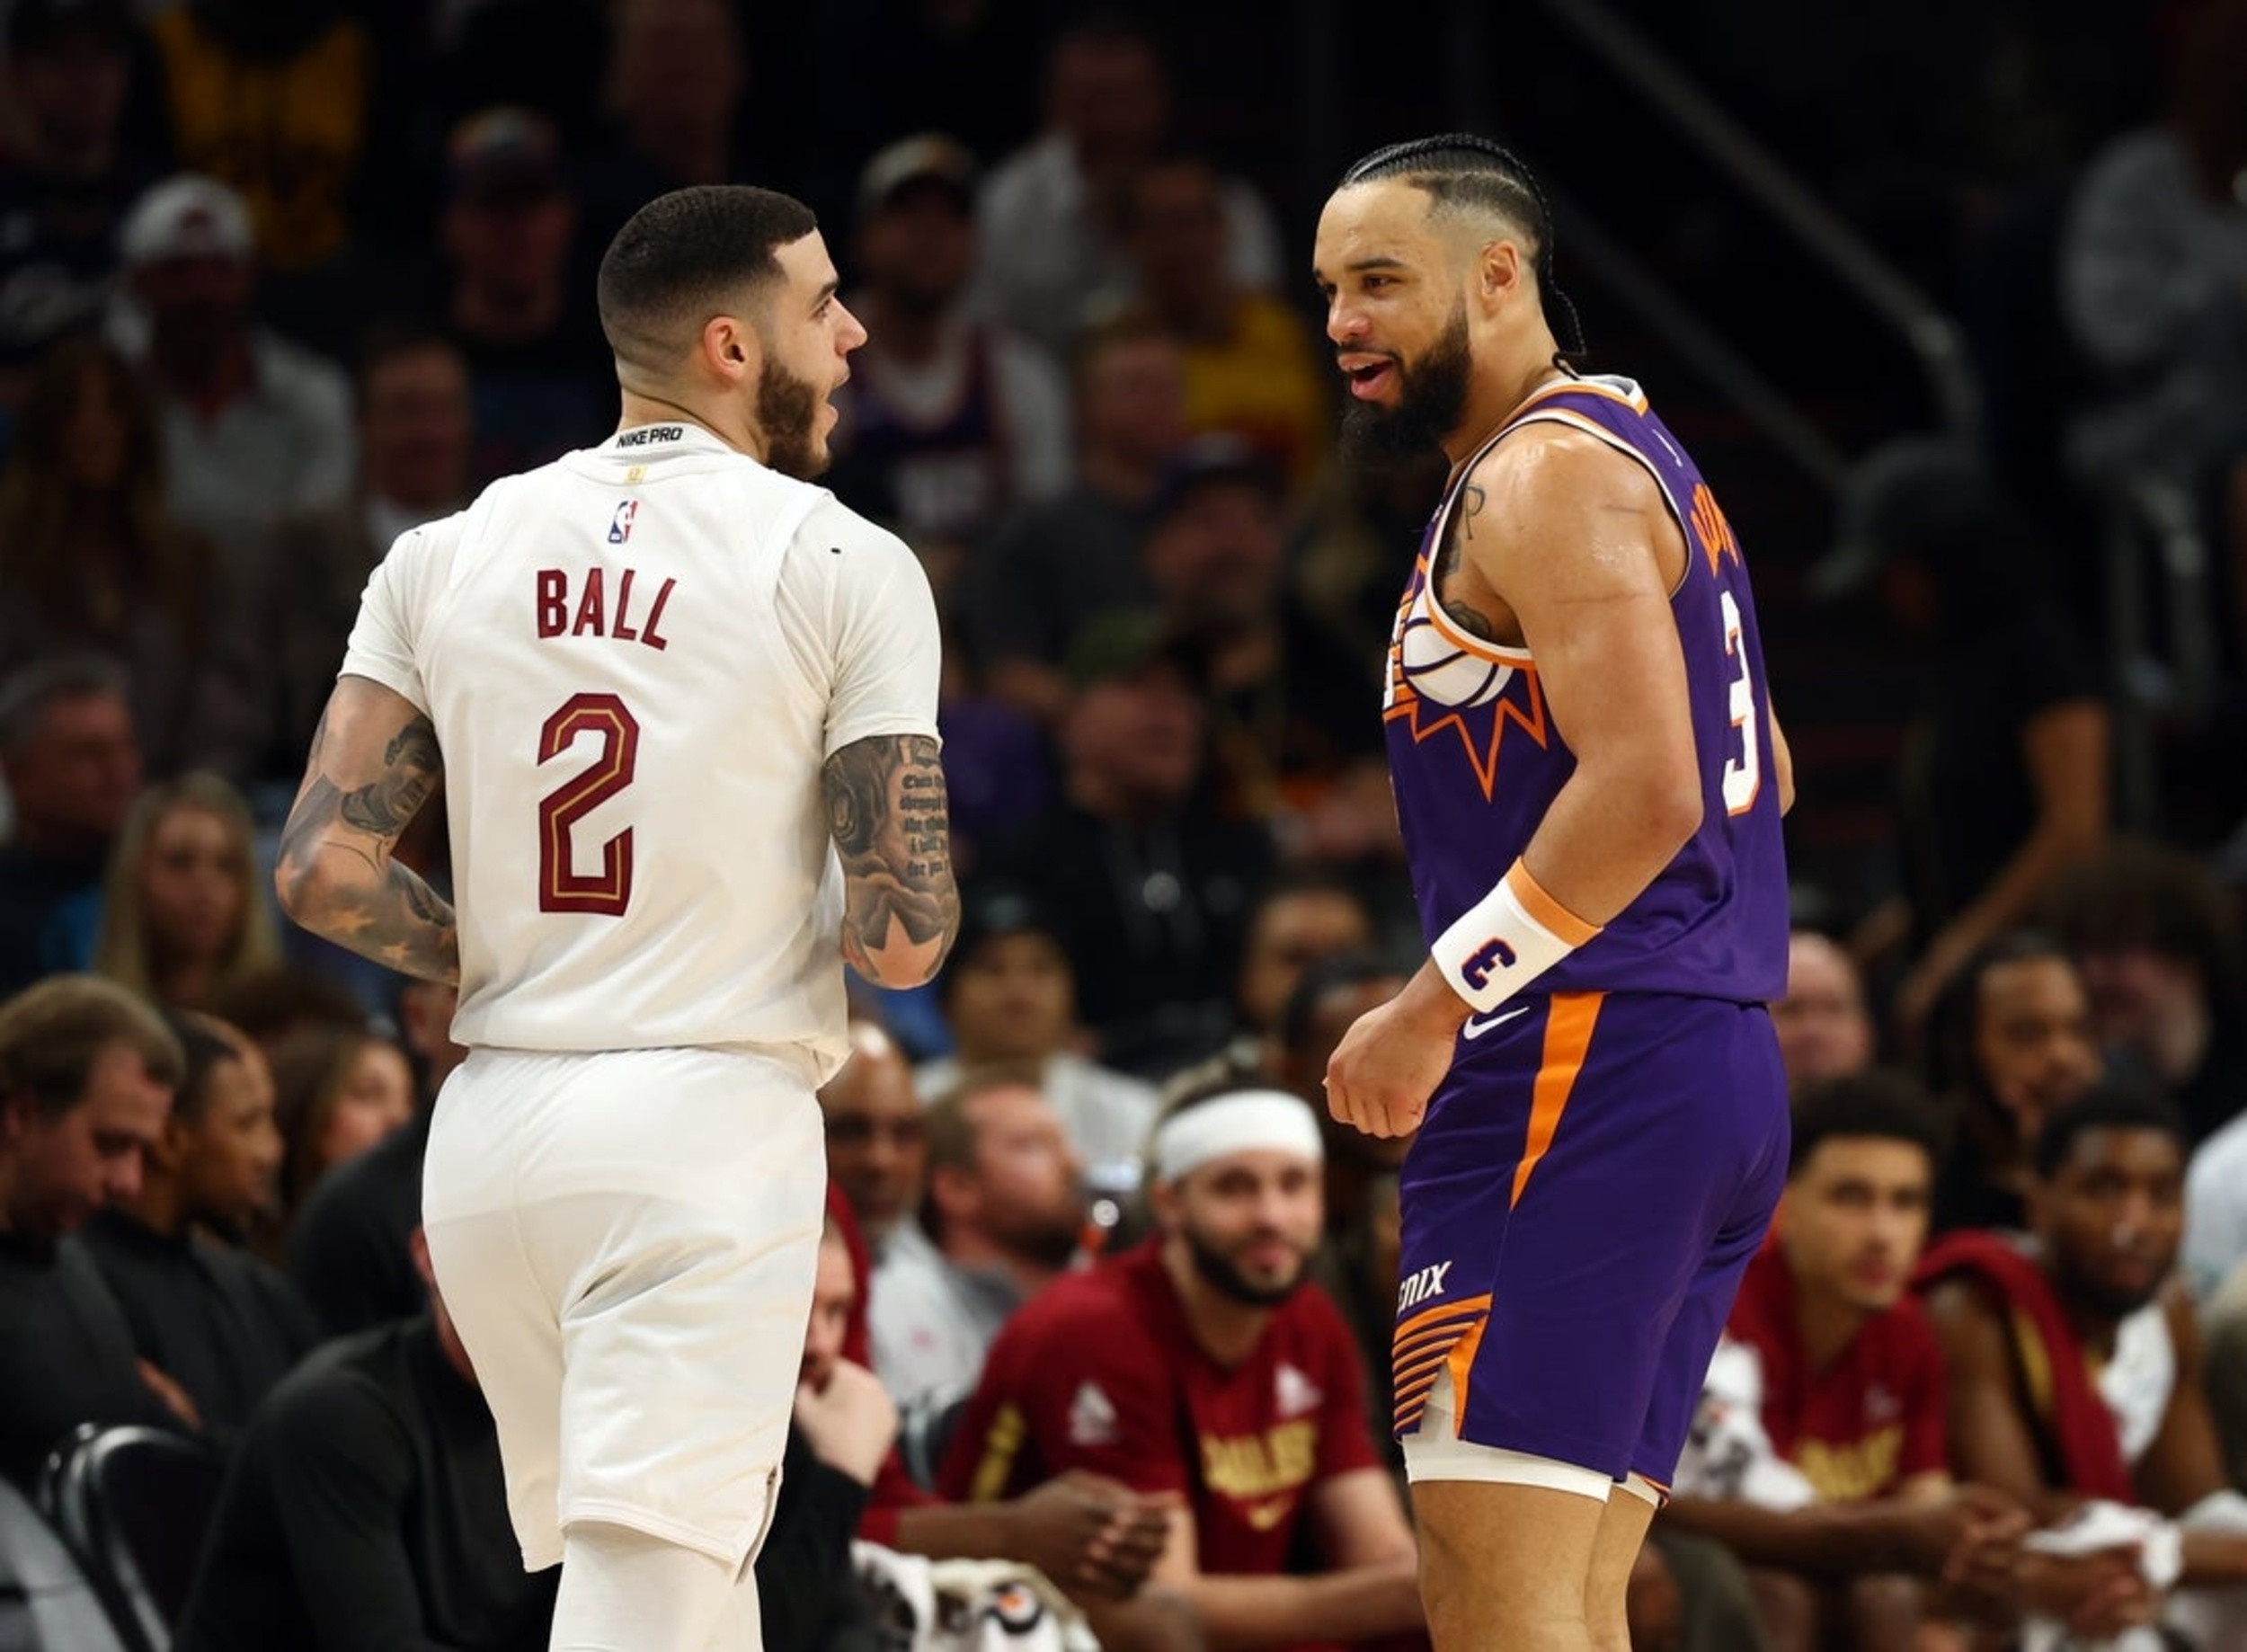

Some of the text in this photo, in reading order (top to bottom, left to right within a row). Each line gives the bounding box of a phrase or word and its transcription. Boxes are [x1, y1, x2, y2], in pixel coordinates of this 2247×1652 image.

[617, 427, 683, 449] NIKE PRO
[537, 568, 677, 651] BALL
[1720, 591, 1760, 817] 3
[537, 693, 640, 916] 2
[1461, 937, 1516, 990] 3
